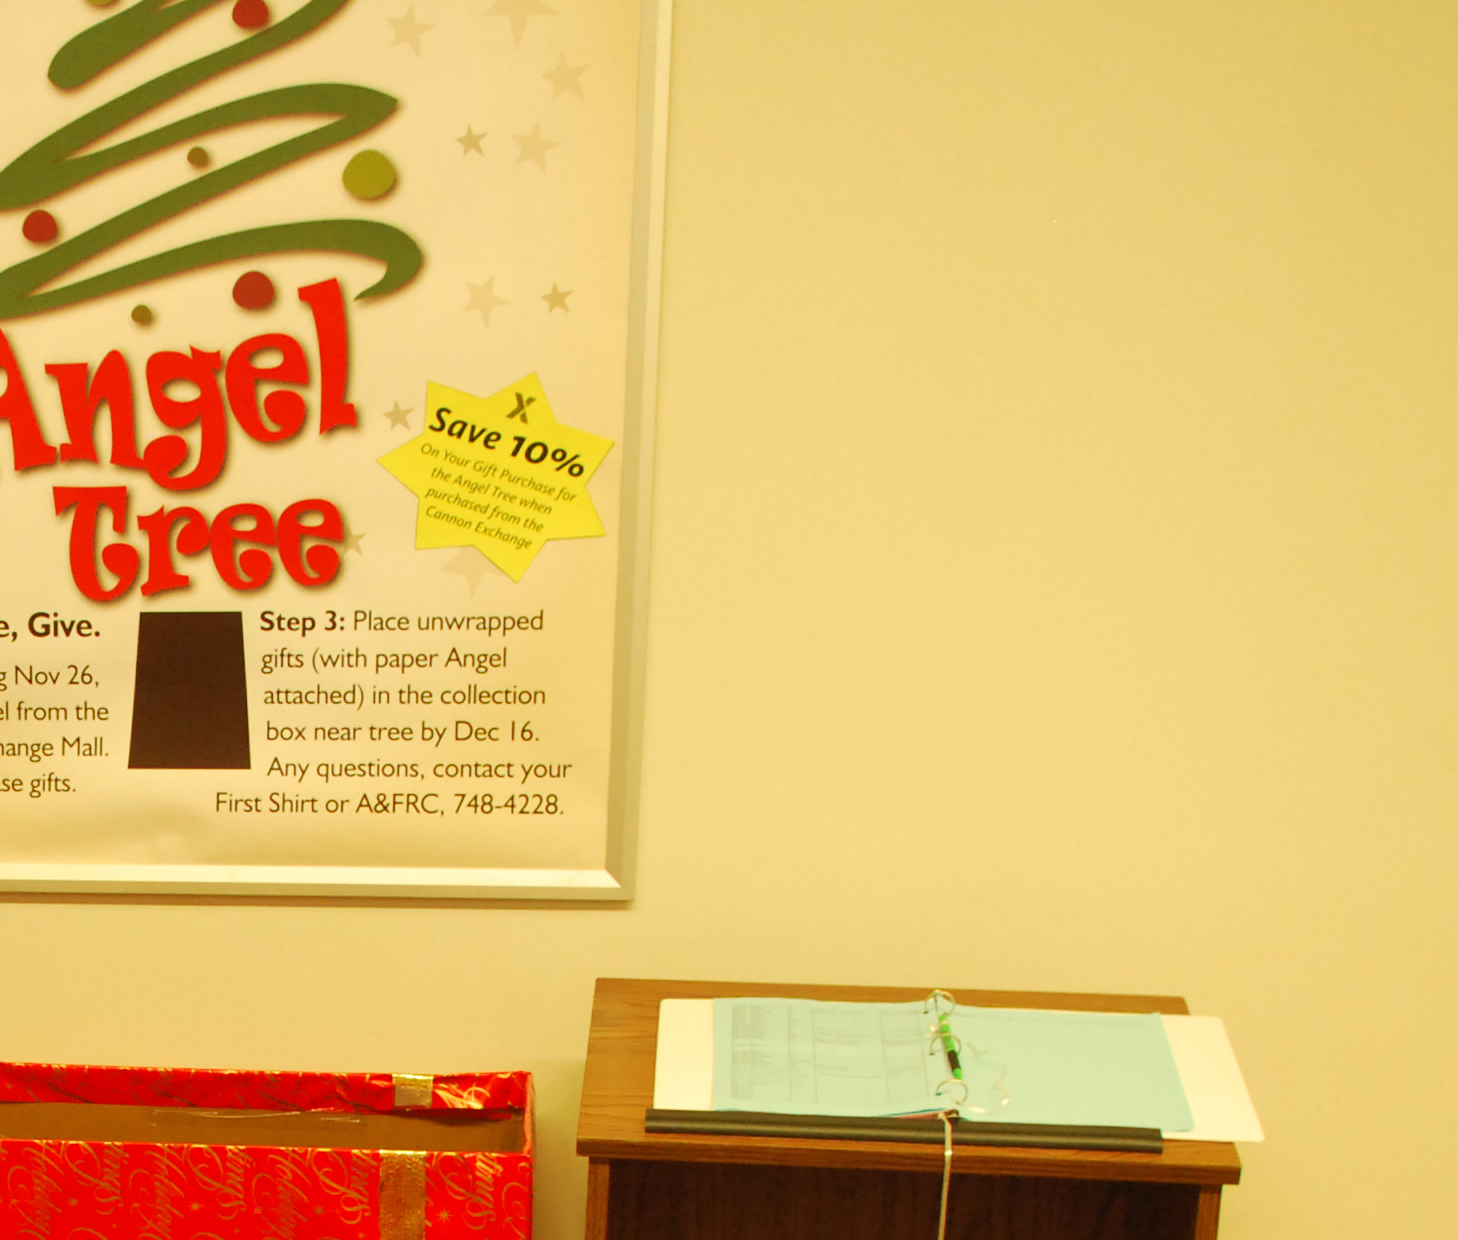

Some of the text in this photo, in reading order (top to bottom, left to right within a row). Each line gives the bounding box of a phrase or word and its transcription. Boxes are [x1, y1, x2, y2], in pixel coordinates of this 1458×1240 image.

[429, 407, 584, 477] Save 10%
[421, 443, 577, 502] On Your Gift Purchase for
[431, 467, 552, 515] the Angel Tree when
[425, 488, 543, 533] purchased from the
[426, 505, 532, 550] Cannon Exchange
[51, 485, 343, 601] Tree
[28, 612, 100, 638] Give.
[260, 610, 544, 637] Step 3: Place unwrapped
[261, 648, 506, 674] gifts (with paper Angel
[15, 666, 60, 685] Nov
[68, 666, 99, 688] 26,
[17, 701, 68, 720] from
[76, 701, 109, 720] the
[264, 684, 545, 711] attached) in the collection
[62, 737, 109, 756] Mall.
[266, 721, 540, 747] box near tree by Dec 16.
[267, 758, 572, 784] Any questions, contact your
[30, 772, 76, 798] gifts.
[216, 793, 564, 817] First Shirt or A&FRC, 748-4228.
